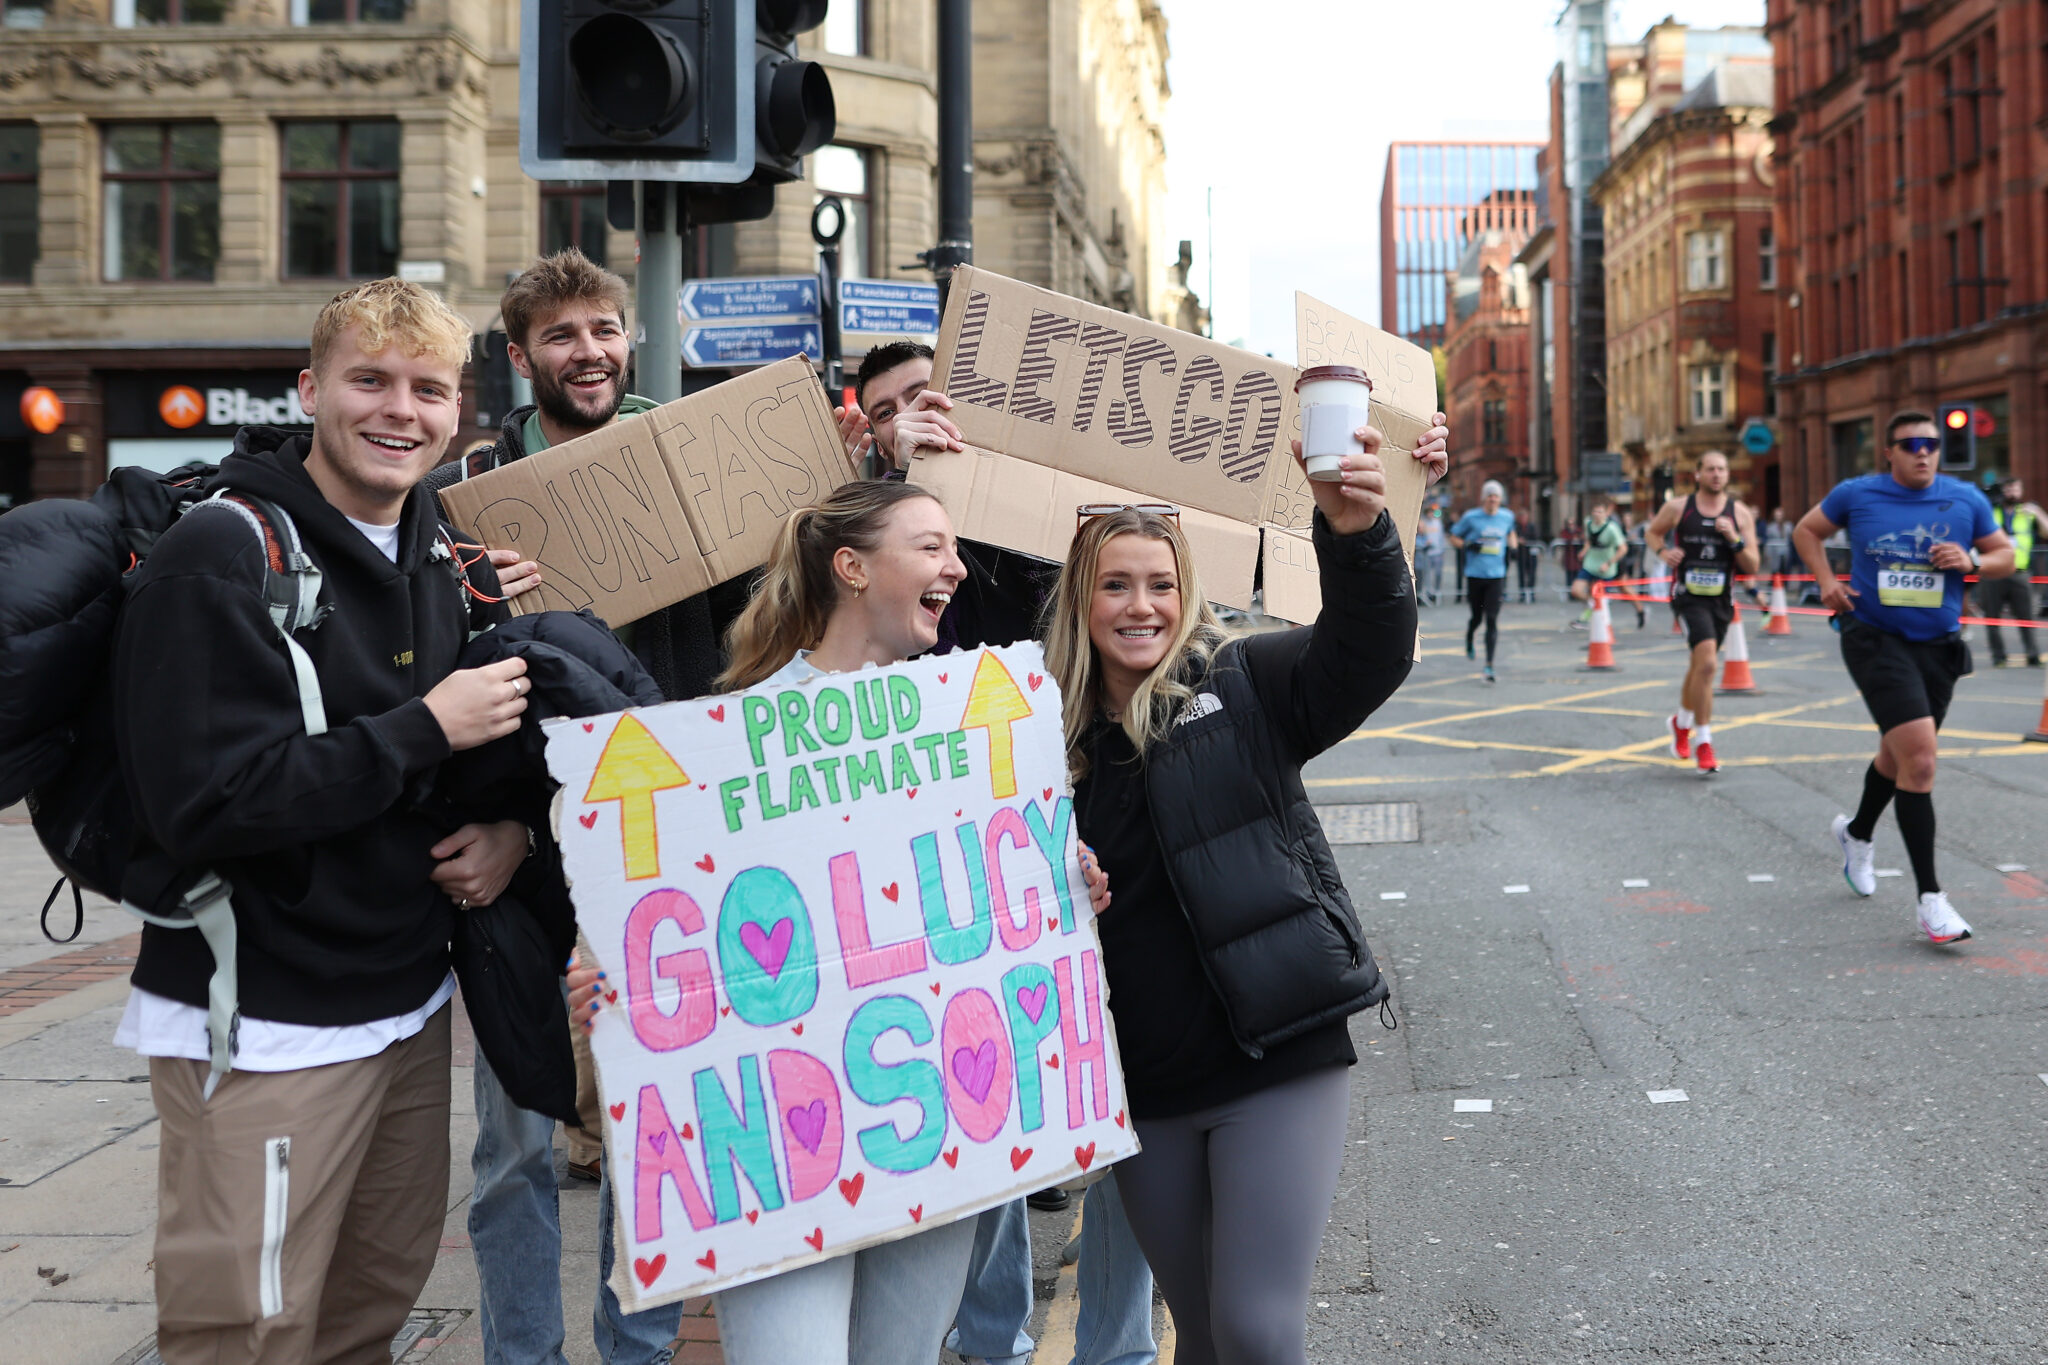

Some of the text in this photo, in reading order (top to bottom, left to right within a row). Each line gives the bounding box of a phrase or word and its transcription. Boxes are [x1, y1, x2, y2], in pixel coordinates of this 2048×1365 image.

[702, 281, 799, 294] Museum of Science
[854, 285, 908, 299] Manchester
[724, 293, 777, 304] & Industry
[702, 303, 789, 315] The Opera House
[860, 308, 909, 319] Town Hall
[862, 318, 933, 331] Register Office
[703, 328, 774, 341] Spinningfields
[765, 338, 800, 349] Square
[1305, 308, 1413, 384] BEANS
[473, 375, 849, 612] RUN FAST
[1887, 574, 1936, 589] 9669
[742, 675, 922, 767] PROUD
[1180, 709, 1206, 726] FACE
[719, 730, 971, 833] FLATMATE
